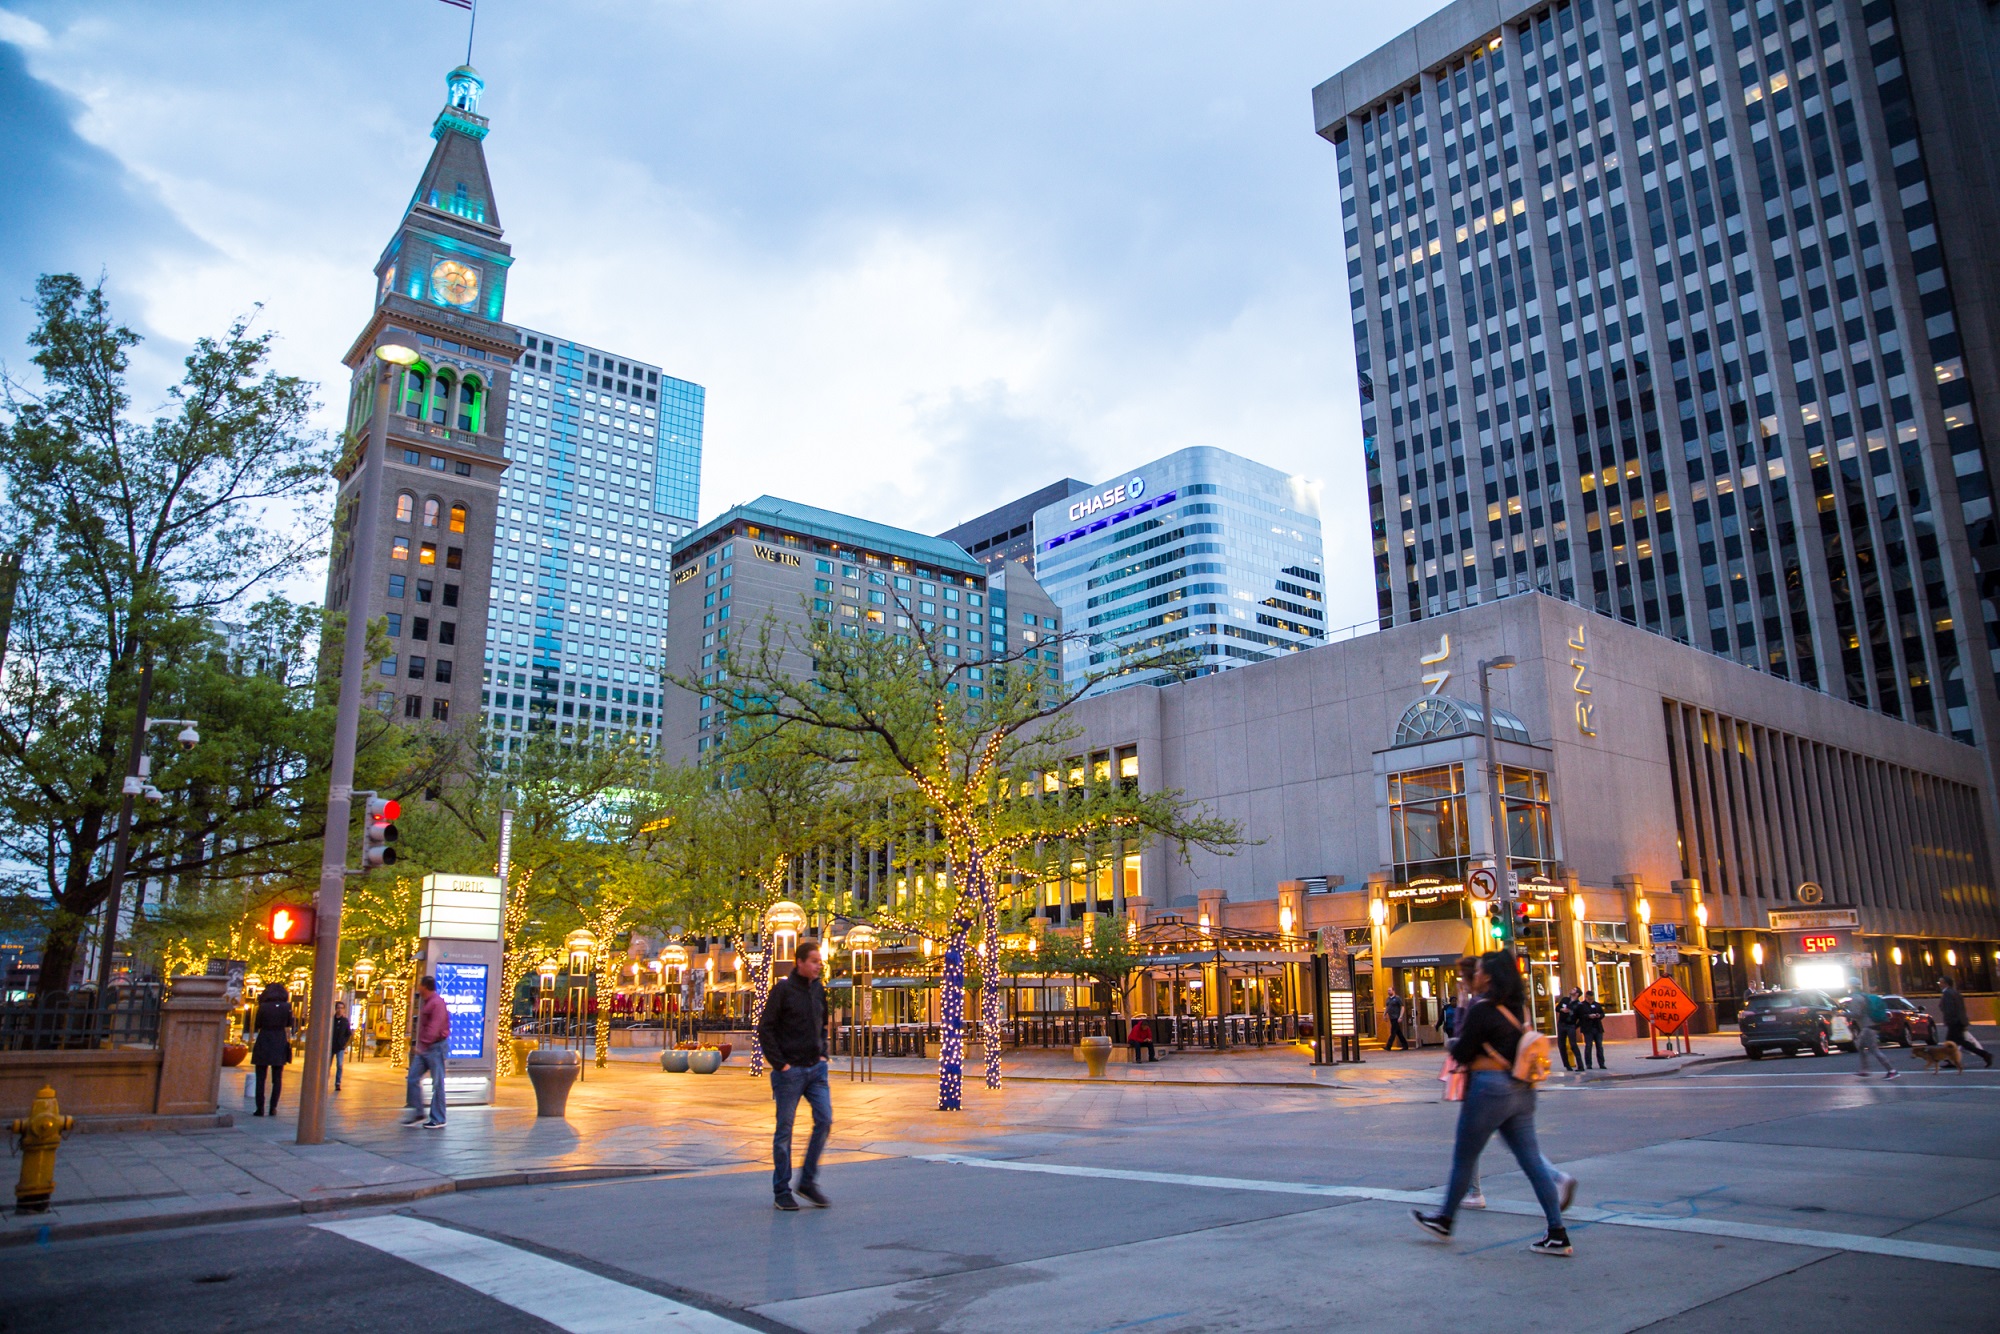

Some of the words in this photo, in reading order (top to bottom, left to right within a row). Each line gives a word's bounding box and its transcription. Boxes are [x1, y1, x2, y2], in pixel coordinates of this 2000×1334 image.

[1069, 484, 1126, 521] CHASE
[753, 544, 801, 567] WESTIN
[674, 564, 700, 585] WESTIN
[500, 819, 512, 877] INFORMATION
[1508, 872, 1516, 880] ONE
[452, 880, 485, 892] CURTIS
[1388, 889, 1418, 898] ROCK
[1419, 884, 1464, 895] BOTTOM
[1805, 887, 1817, 900] P
[1651, 988, 1677, 997] ROAD
[1650, 1000, 1677, 1009] WORK
